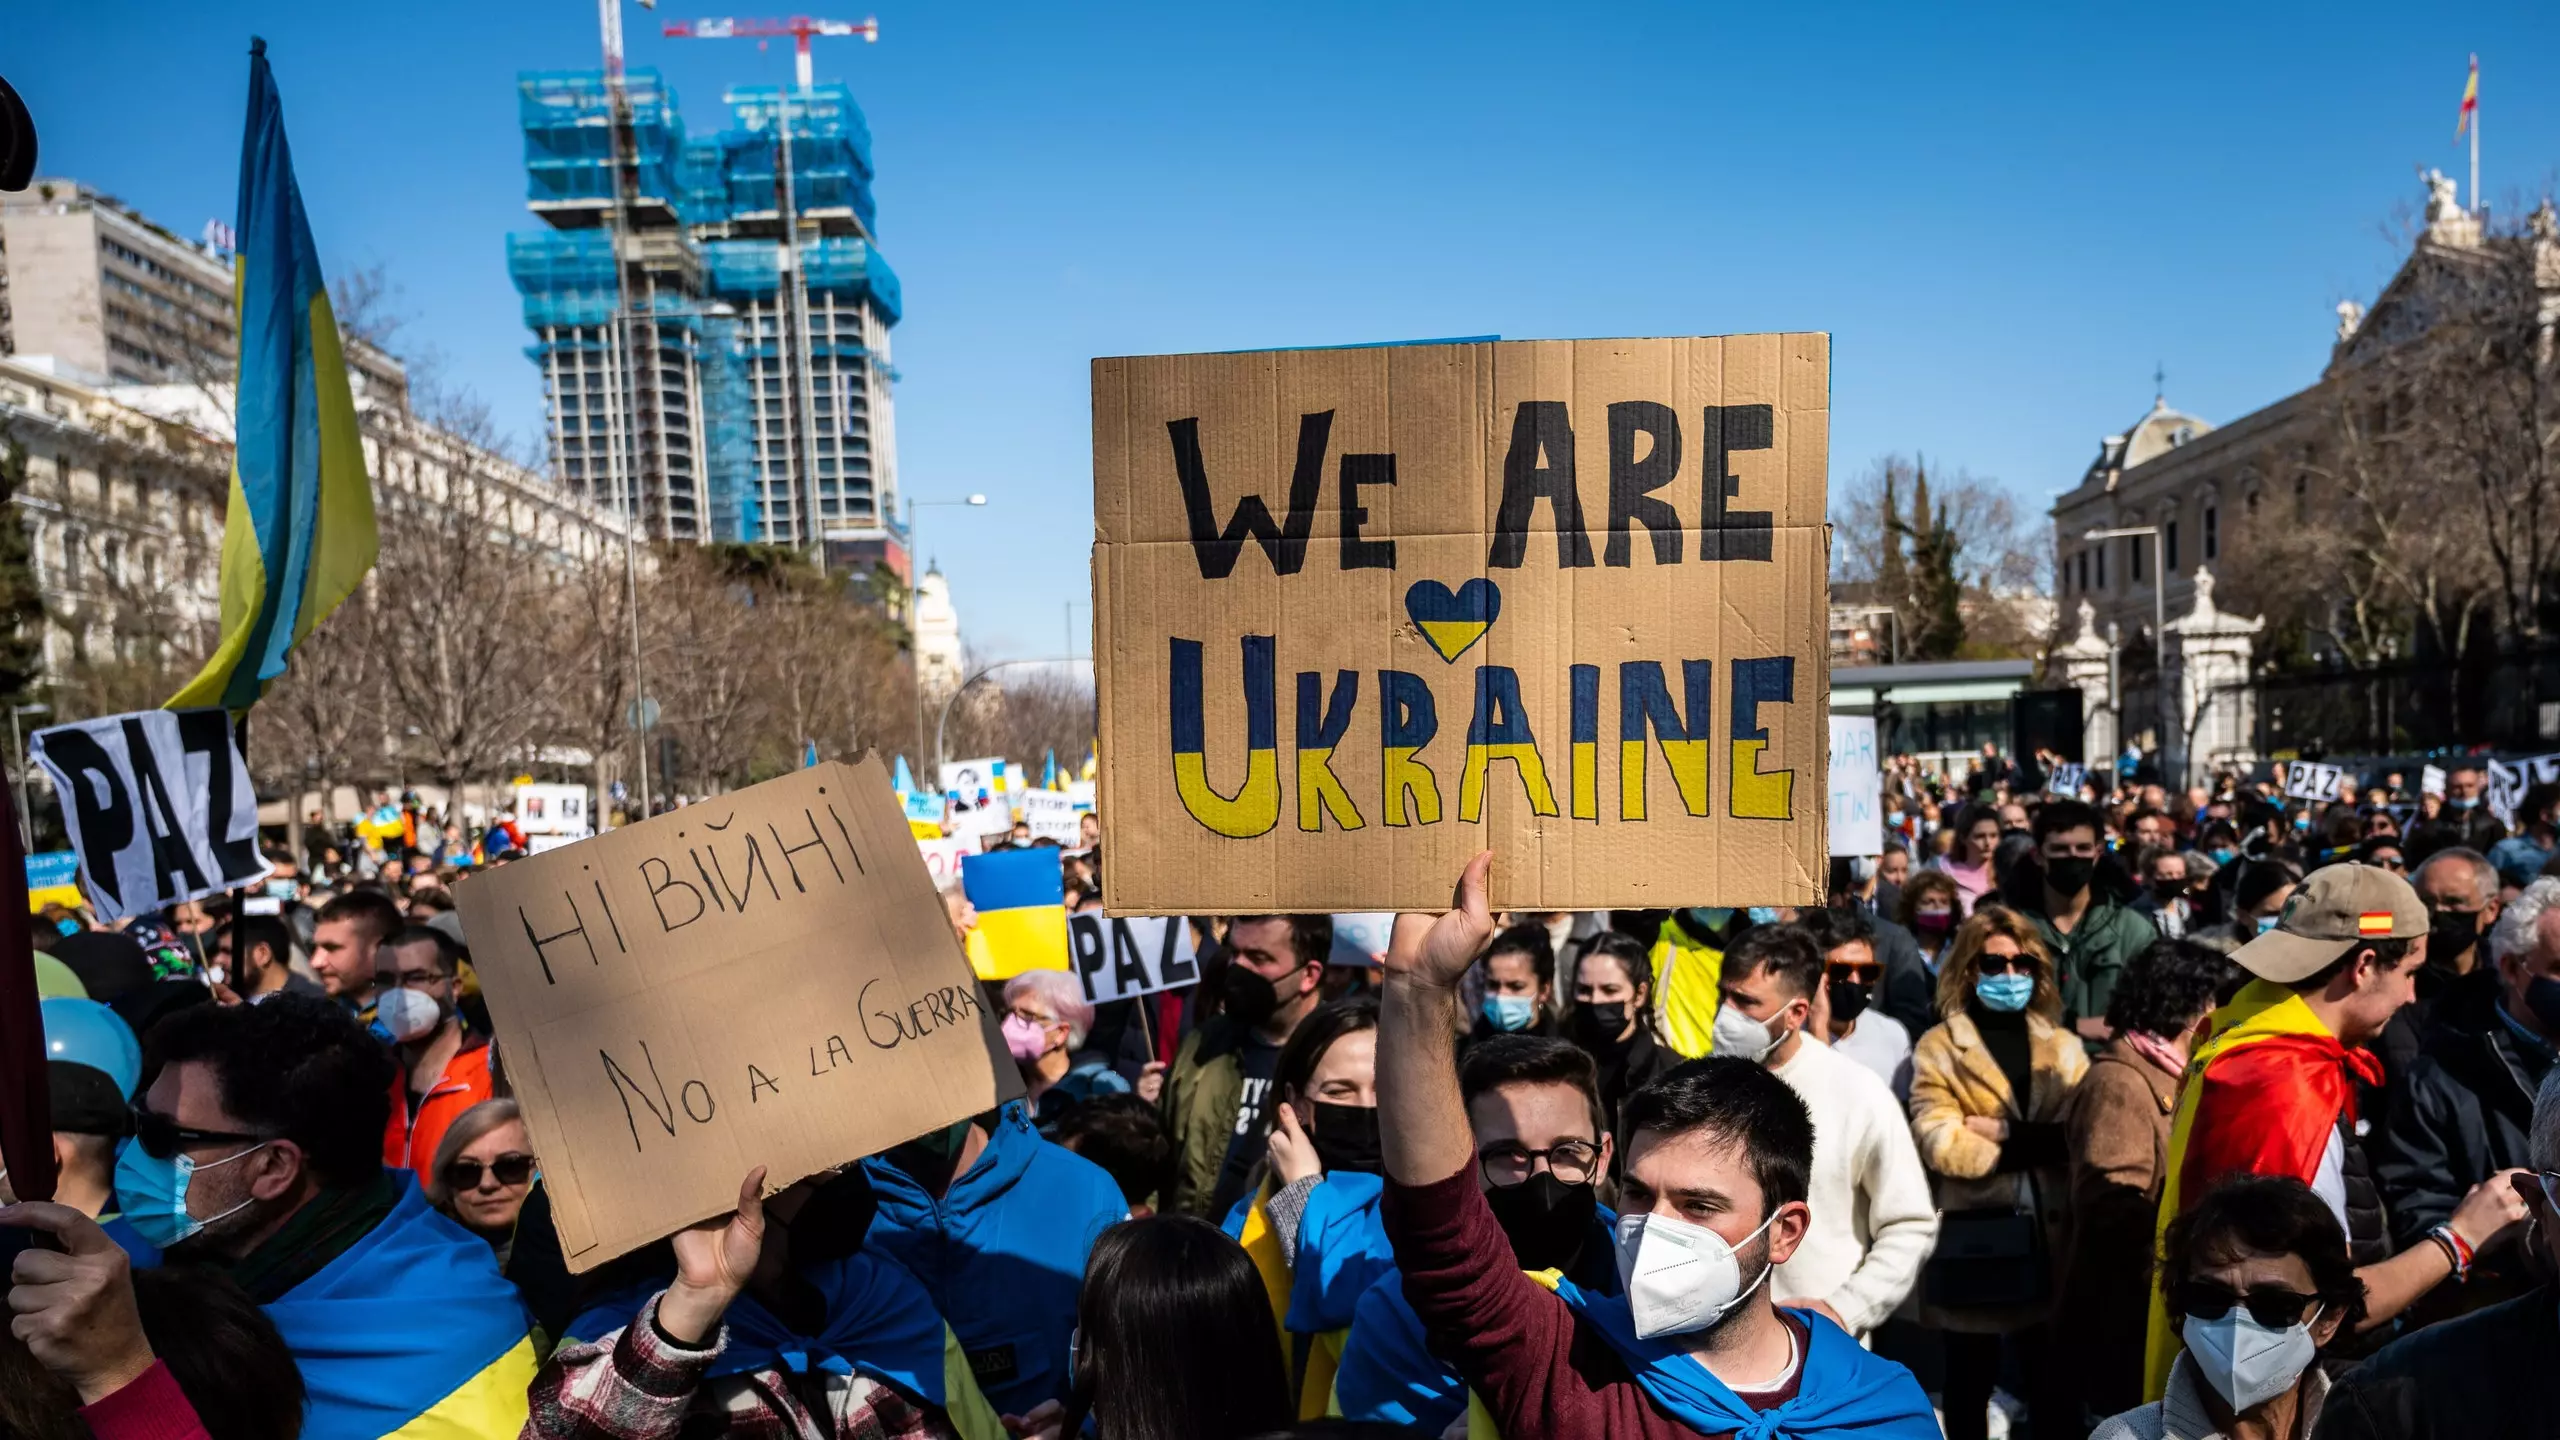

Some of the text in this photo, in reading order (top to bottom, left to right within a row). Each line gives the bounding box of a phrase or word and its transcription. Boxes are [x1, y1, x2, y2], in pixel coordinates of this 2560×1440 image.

[1166, 400, 1775, 579] WE ARE
[40, 709, 267, 911] PAZ
[1169, 634, 1795, 840] UKRAINE
[2289, 766, 2338, 797] PAZ
[1069, 914, 1196, 1002] PAZ
[747, 1062, 781, 1104] A
[809, 1034, 854, 1077] LA
[857, 977, 987, 1050] GUERRA
